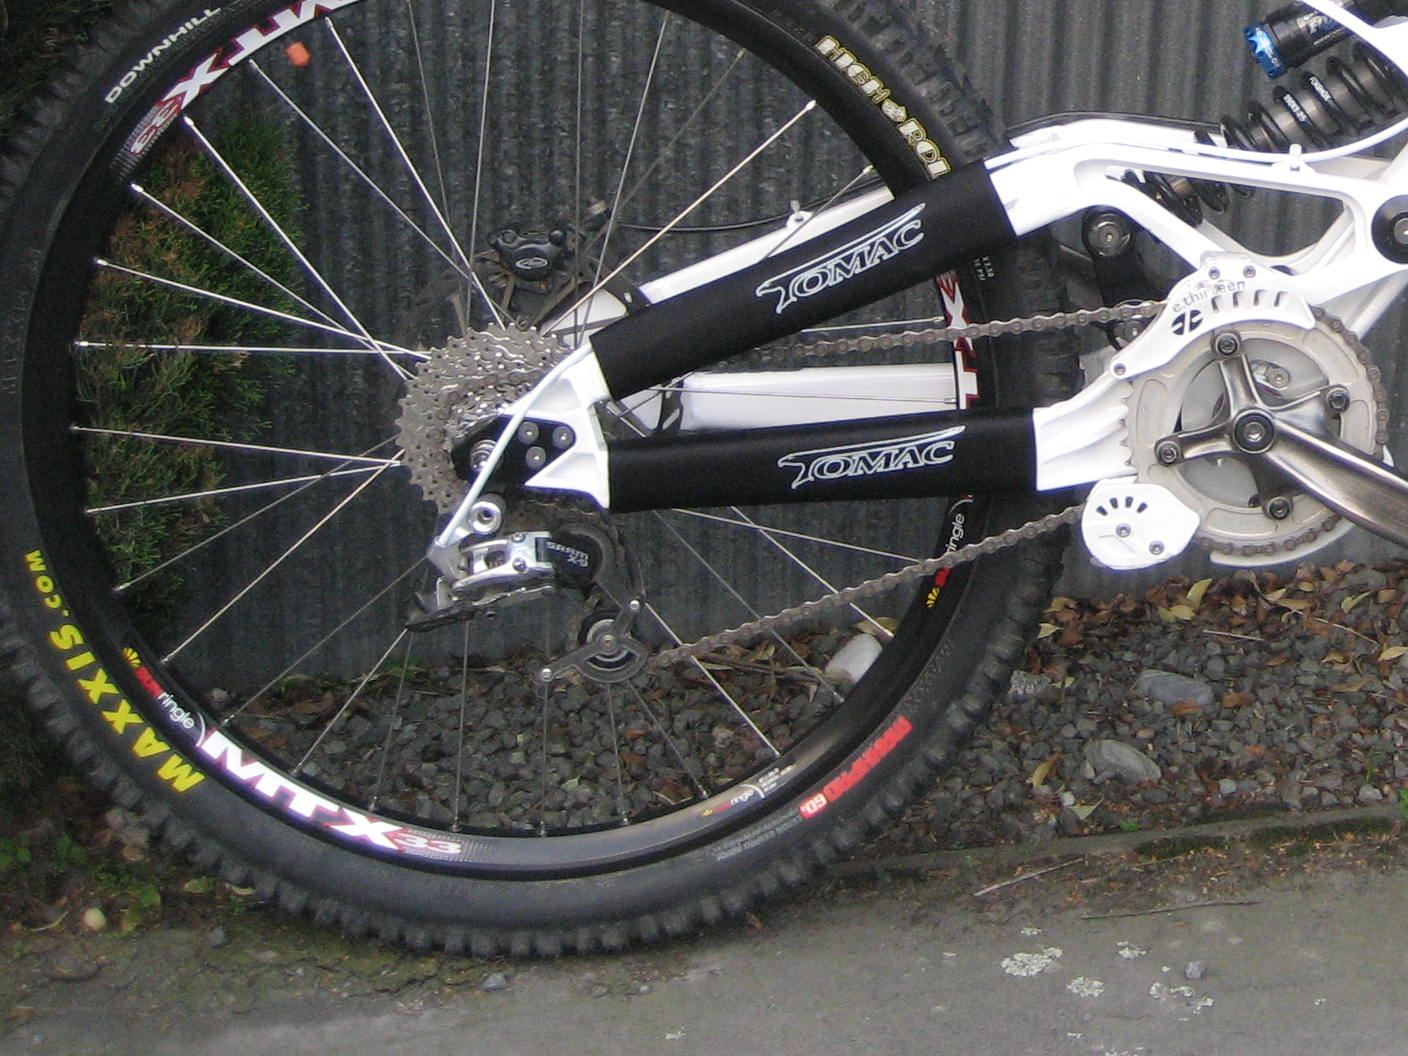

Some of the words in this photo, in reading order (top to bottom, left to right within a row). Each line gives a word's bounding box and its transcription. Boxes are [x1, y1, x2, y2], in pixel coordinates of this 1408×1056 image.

[104, 6, 222, 105] DOWNHILL
[815, 34, 892, 105] HIGH
[896, 116, 951, 182] ROL
[756, 202, 926, 315] TOMAC
[777, 425, 967, 490] TOMAC
